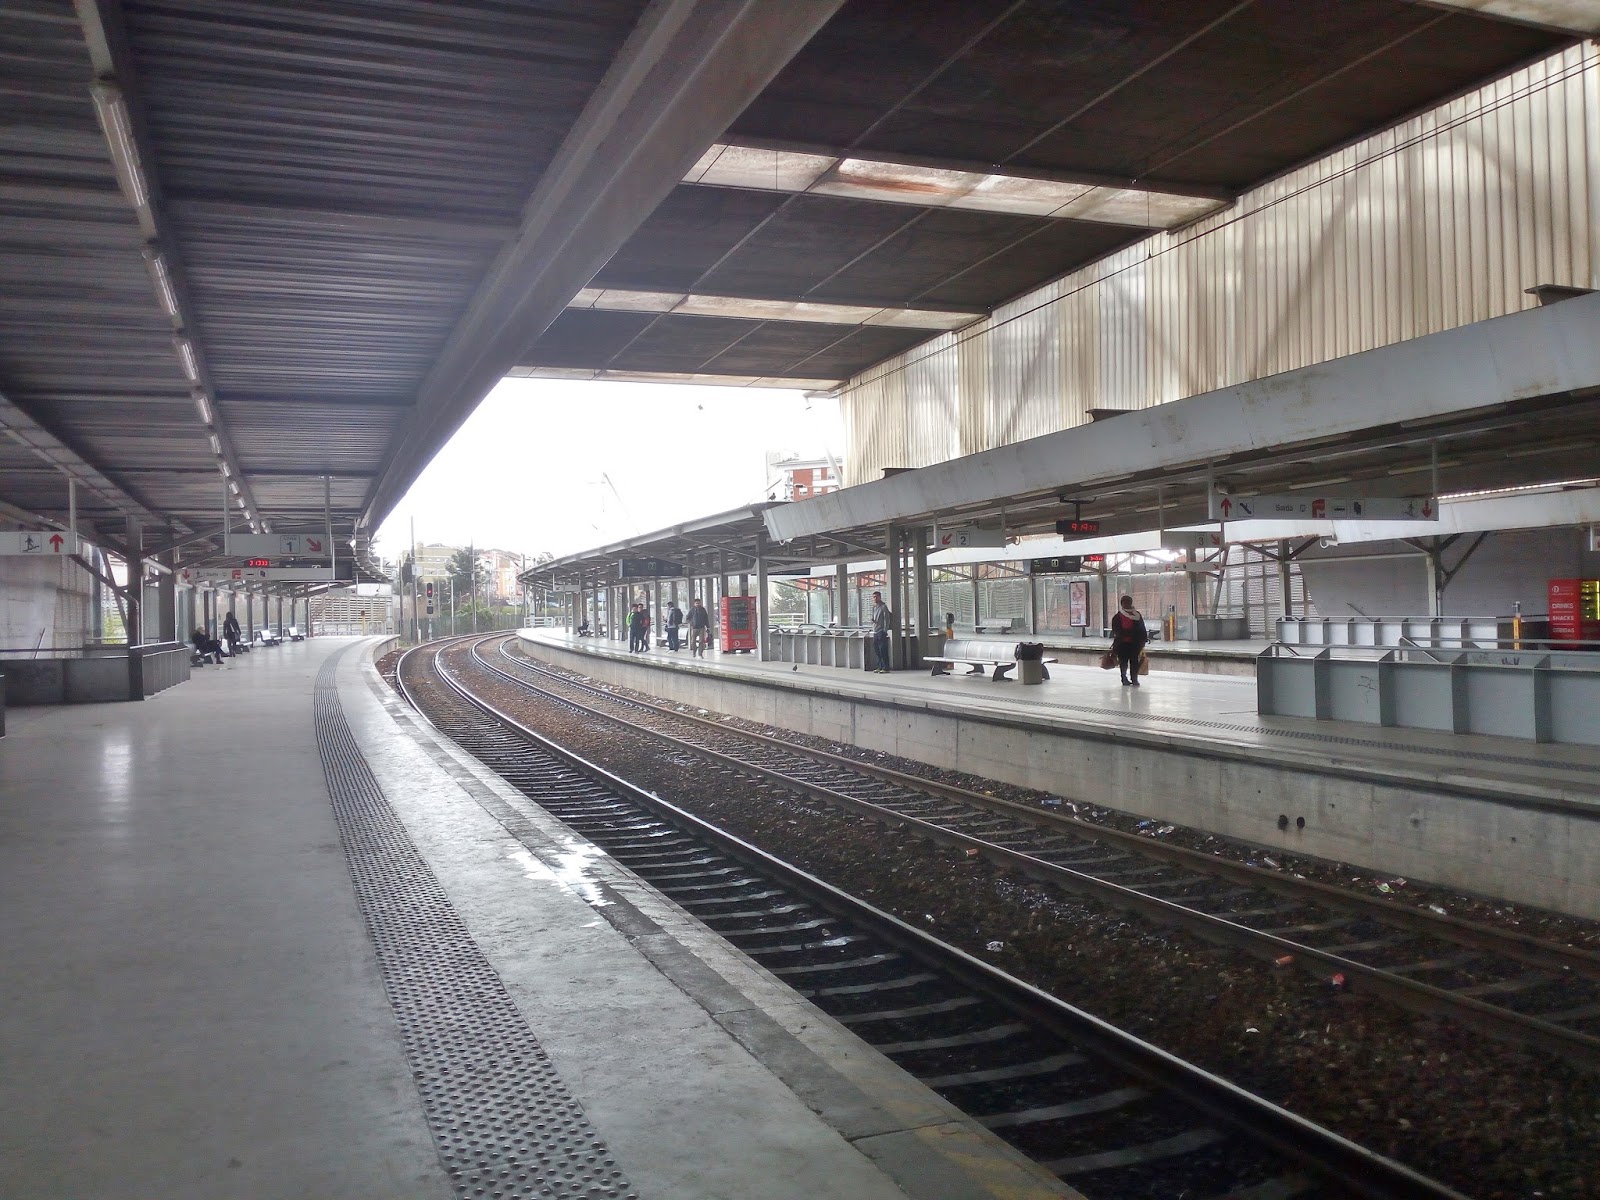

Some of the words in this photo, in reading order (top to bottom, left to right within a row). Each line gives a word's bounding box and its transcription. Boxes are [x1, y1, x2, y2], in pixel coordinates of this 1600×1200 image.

[960, 536, 967, 545] 2
[1198, 537, 1204, 546] 3
[286, 541, 293, 552] 1
